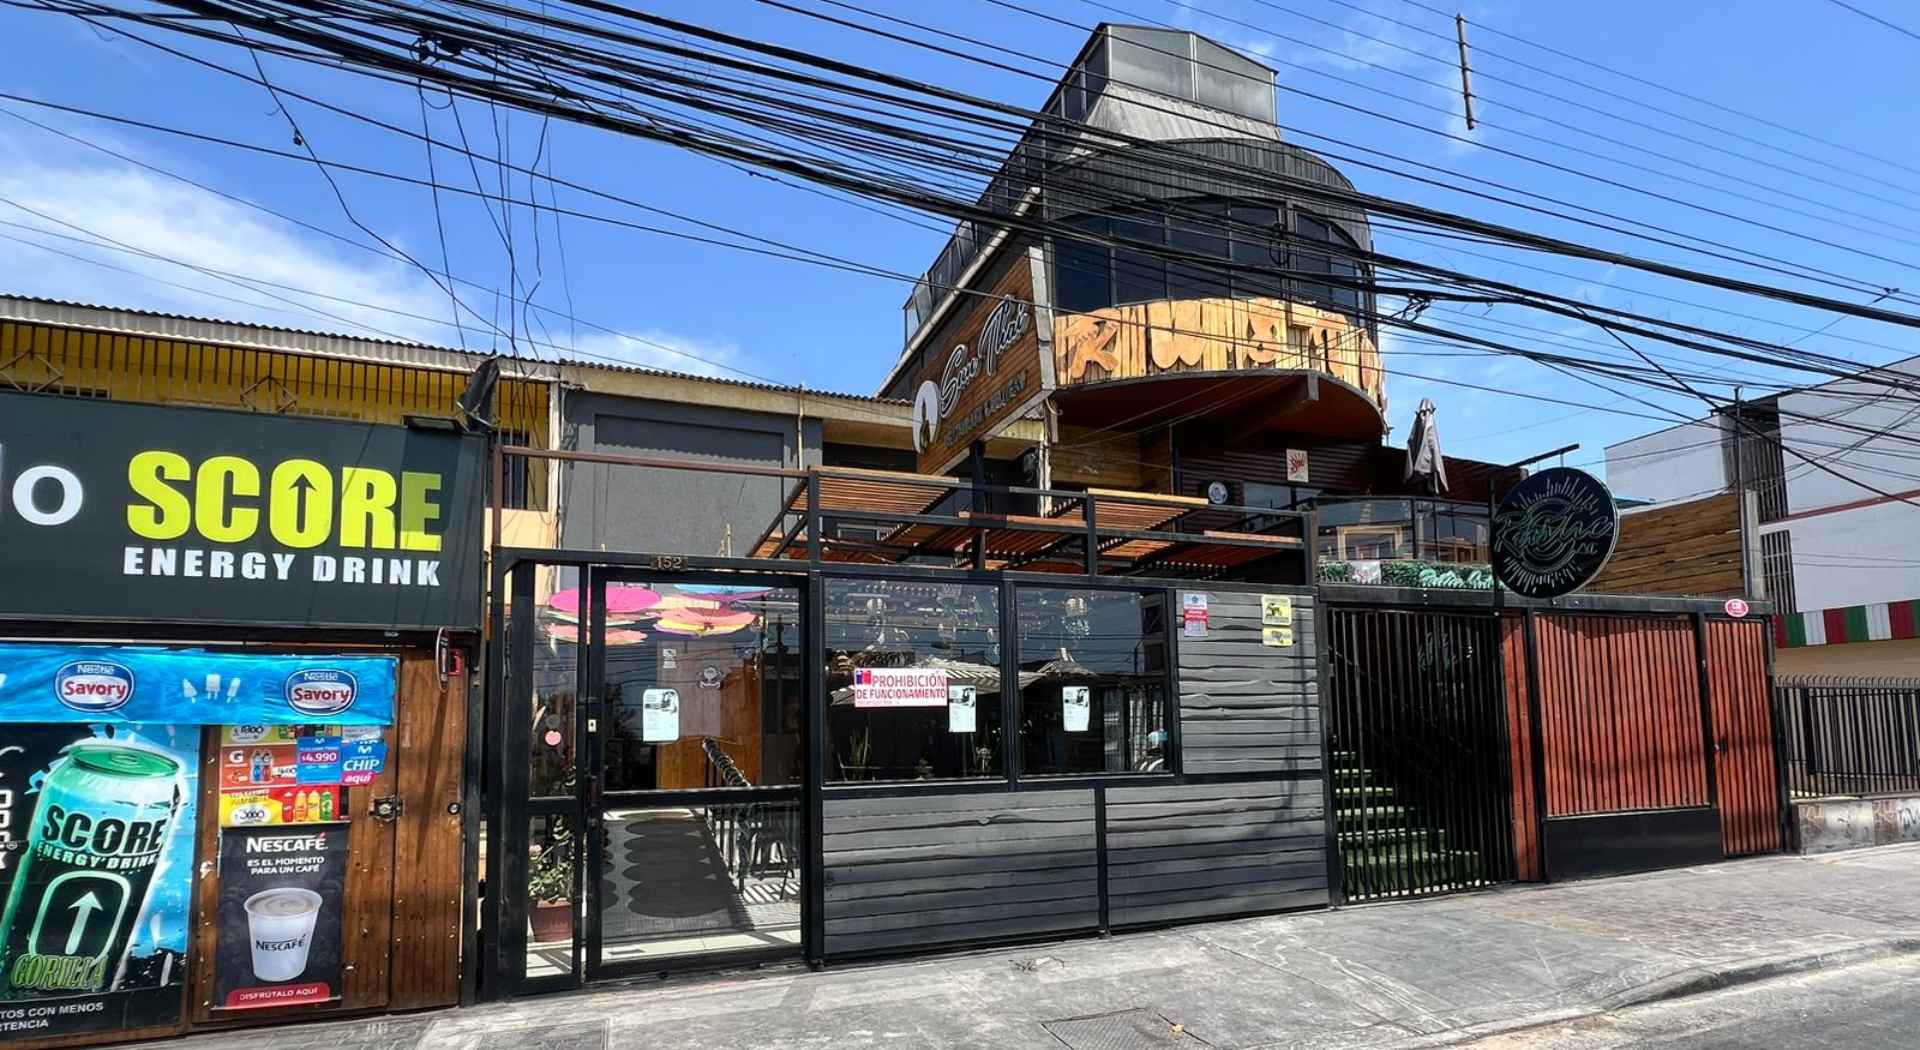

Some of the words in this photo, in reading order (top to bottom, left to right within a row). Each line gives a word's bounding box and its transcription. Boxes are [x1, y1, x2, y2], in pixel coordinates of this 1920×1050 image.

[127, 450, 442, 552] SCORE
[123, 546, 296, 581] ENERGY
[312, 555, 441, 587] DRINK
[658, 556, 681, 569] 152
[872, 671, 945, 687] PROHIBICIÓN
[64, 681, 127, 699] Savory
[294, 687, 349, 703] Savory
[856, 689, 867, 699] DE
[869, 688, 945, 699] FUNCIONAMIENTO
[343, 760, 380, 772] CHIP
[42, 804, 167, 855] SCORE
[246, 832, 328, 853] NESCAFÉ
[247, 859, 260, 867] ES
[262, 859, 273, 867] EL
[275, 857, 325, 866] MOMENTO
[251, 866, 278, 875] PARA
[279, 865, 294, 874] UN
[295, 863, 320, 873] CAFÉ
[256, 934, 307, 951] NESCAFÉ
[240, 988, 294, 1000] DISFRÚTALO
[28, 1007, 56, 1017] CON
[59, 1002, 104, 1014] MENOS
